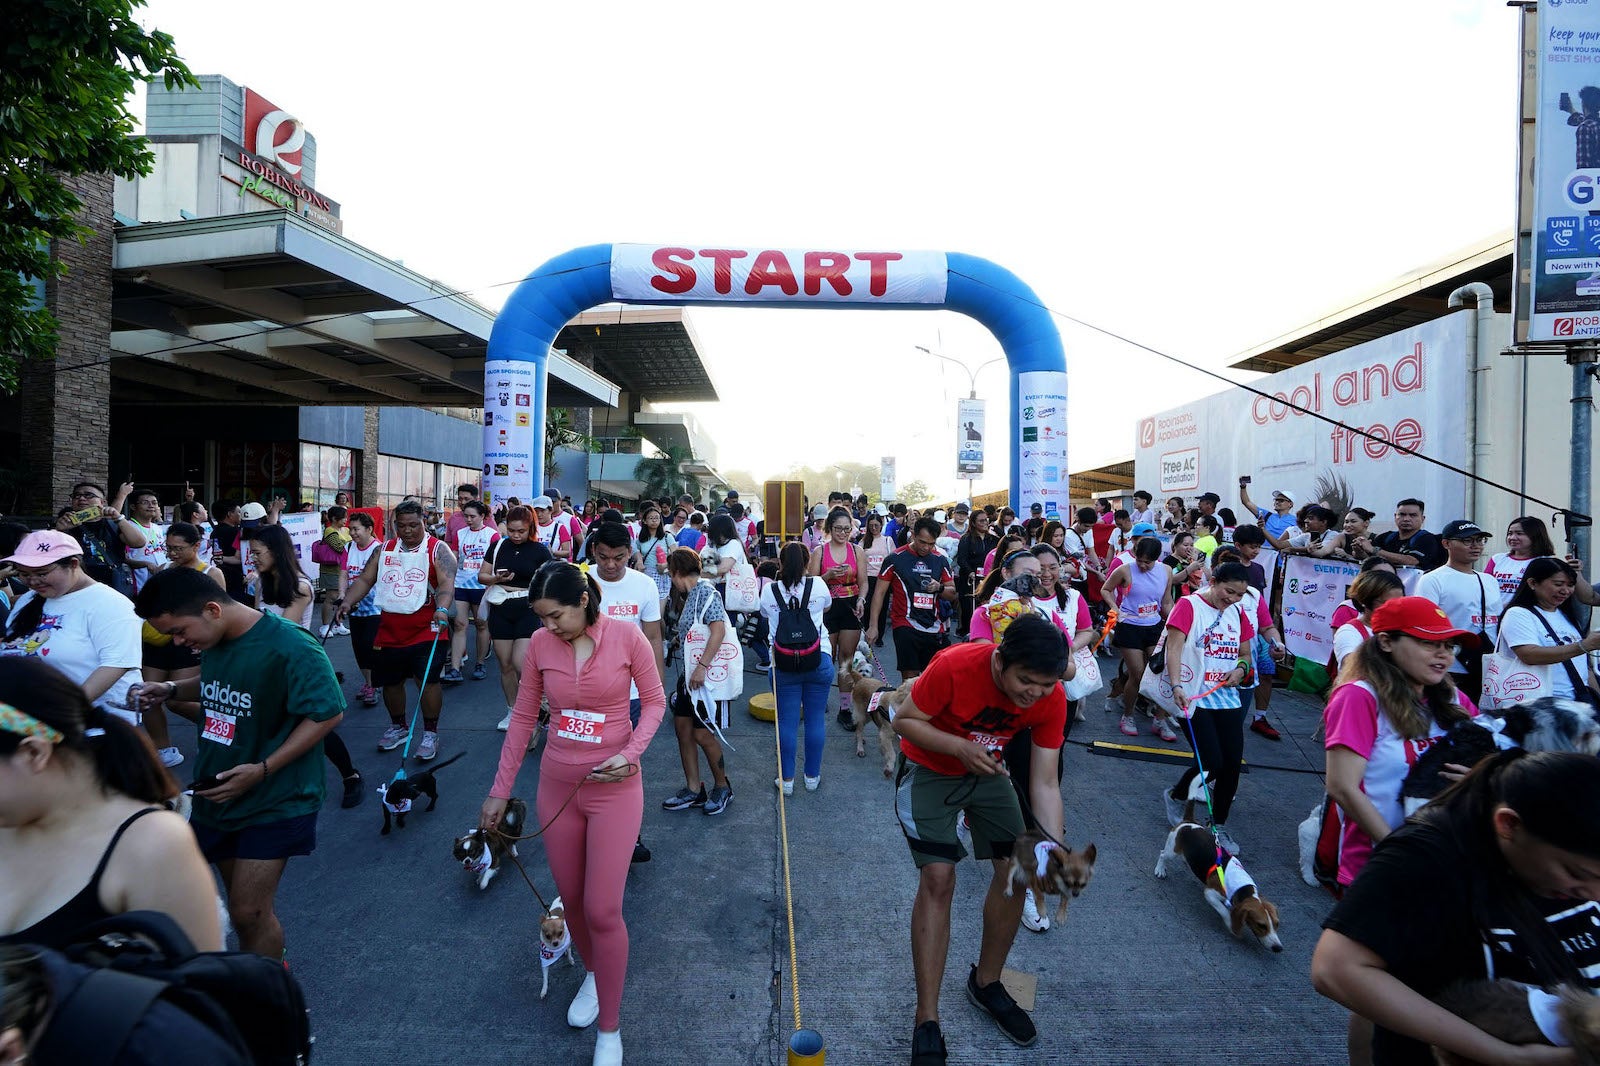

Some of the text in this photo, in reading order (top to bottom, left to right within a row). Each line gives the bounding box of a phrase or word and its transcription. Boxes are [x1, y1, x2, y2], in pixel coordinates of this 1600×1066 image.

[1549, 26, 1575, 45] keep
[1548, 54, 1571, 63] BEST
[1574, 55, 1592, 63] SIM
[239, 151, 331, 213] ROBINSONS
[238, 174, 294, 210] place
[1551, 219, 1576, 229] UNLI
[650, 246, 903, 298] START
[1551, 263, 1572, 271] Now
[1574, 261, 1593, 270] with
[1575, 316, 1599, 327] ROB
[1252, 341, 1423, 425] cool and
[1158, 412, 1193, 430] Robinsons
[1158, 424, 1197, 444] Appliances
[1331, 417, 1423, 464] free
[1163, 456, 1196, 474] Free AC
[1314, 564, 1341, 575] EVENT
[613, 605, 633, 615] 433
[1219, 646, 1239, 654] WALK
[202, 700, 252, 718] ORTSWEAR
[209, 718, 231, 737] 239
[566, 718, 595, 735] 335
